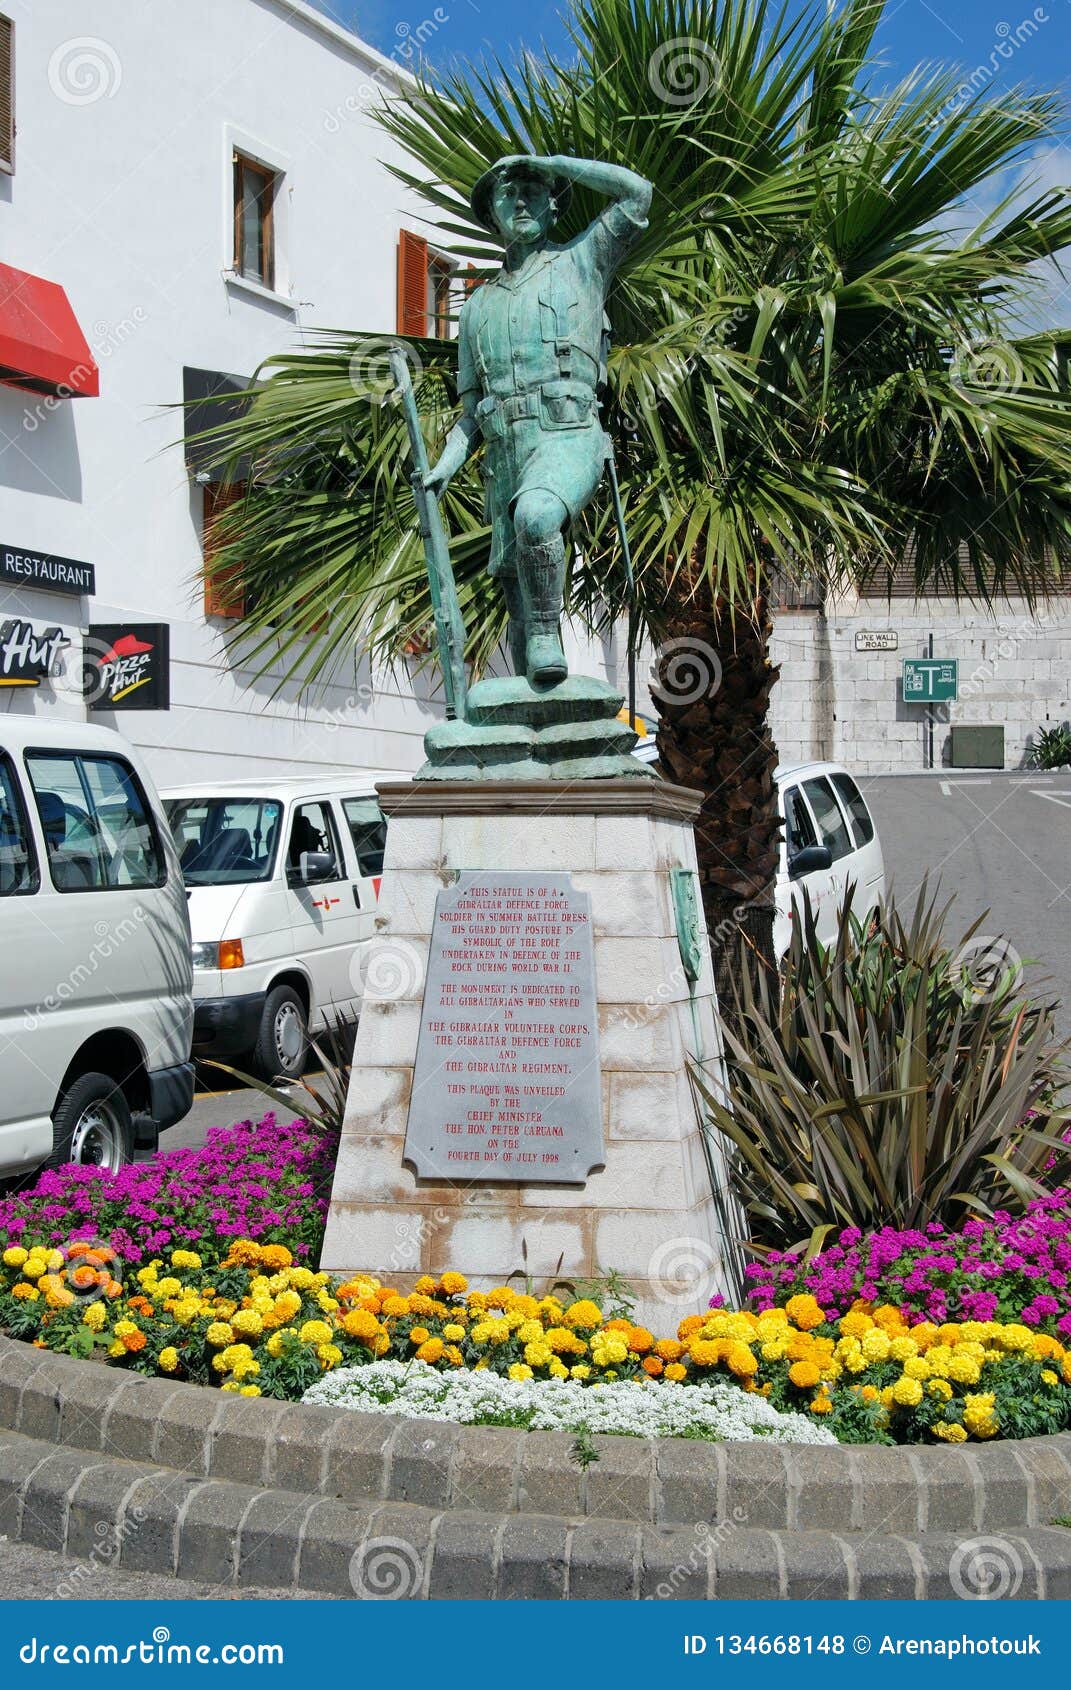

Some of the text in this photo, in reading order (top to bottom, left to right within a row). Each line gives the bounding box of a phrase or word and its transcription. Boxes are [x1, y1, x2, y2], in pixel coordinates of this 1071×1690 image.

[5, 553, 92, 587] RESTAURANT
[1, 622, 70, 674] Hut
[101, 653, 151, 689] Pizza
[111, 668, 146, 695] Hut
[471, 888, 557, 897] THIS STATUE IS OF A
[457, 901, 568, 910] GIBRALTAR DEFENCE FORCE
[440, 913, 472, 921] SOLDIER
[476, 914, 485, 922] IN
[489, 914, 523, 922] SUMMER
[528, 915, 557, 923] BATTLE
[452, 926, 573, 935] HIS GUARD DUTY POSTURE IS
[464, 938, 560, 947] SYMBOLIC OF THE ROLE
[442, 951, 581, 960] UNDERTAKEN IN DEFENCE OF THE
[451, 964, 472, 972] ROCK
[477, 964, 507, 972] DURING
[512, 964, 538, 972] WORLD
[543, 964, 559, 972] WAR
[441, 985, 580, 994] THE MONUMENT IS DEDICATED TO
[440, 998, 580, 1007] ALL GIBRALTARIANS WHO SERVED
[505, 1011, 513, 1019] IN
[428, 1023, 445, 1031] THE
[450, 1024, 499, 1032] GIBRALTAR
[504, 1024, 555, 1033] VOLUNTEER
[435, 1036, 581, 1047] THE GIBRALTAR DEFENCE FORCE
[499, 1051, 516, 1059] AND
[445, 1062, 462, 1072] THE
[468, 1063, 517, 1072] GIBRALTAR
[447, 1085, 565, 1096] THIS PLAQUE WAS UNVEILED
[490, 1098, 520, 1108] BY THE
[467, 1111, 542, 1122] CHIEF MINISTER
[445, 1125, 462, 1134] THE
[491, 1125, 519, 1136] PETER
[523, 1127, 564, 1136] CARUANA
[488, 1140, 519, 1148] ON THE
[448, 1152, 480, 1160] FOURTH
[483, 1153, 499, 1161] DAY
[503, 1153, 513, 1161] OF
[517, 1154, 537, 1162] JULY
